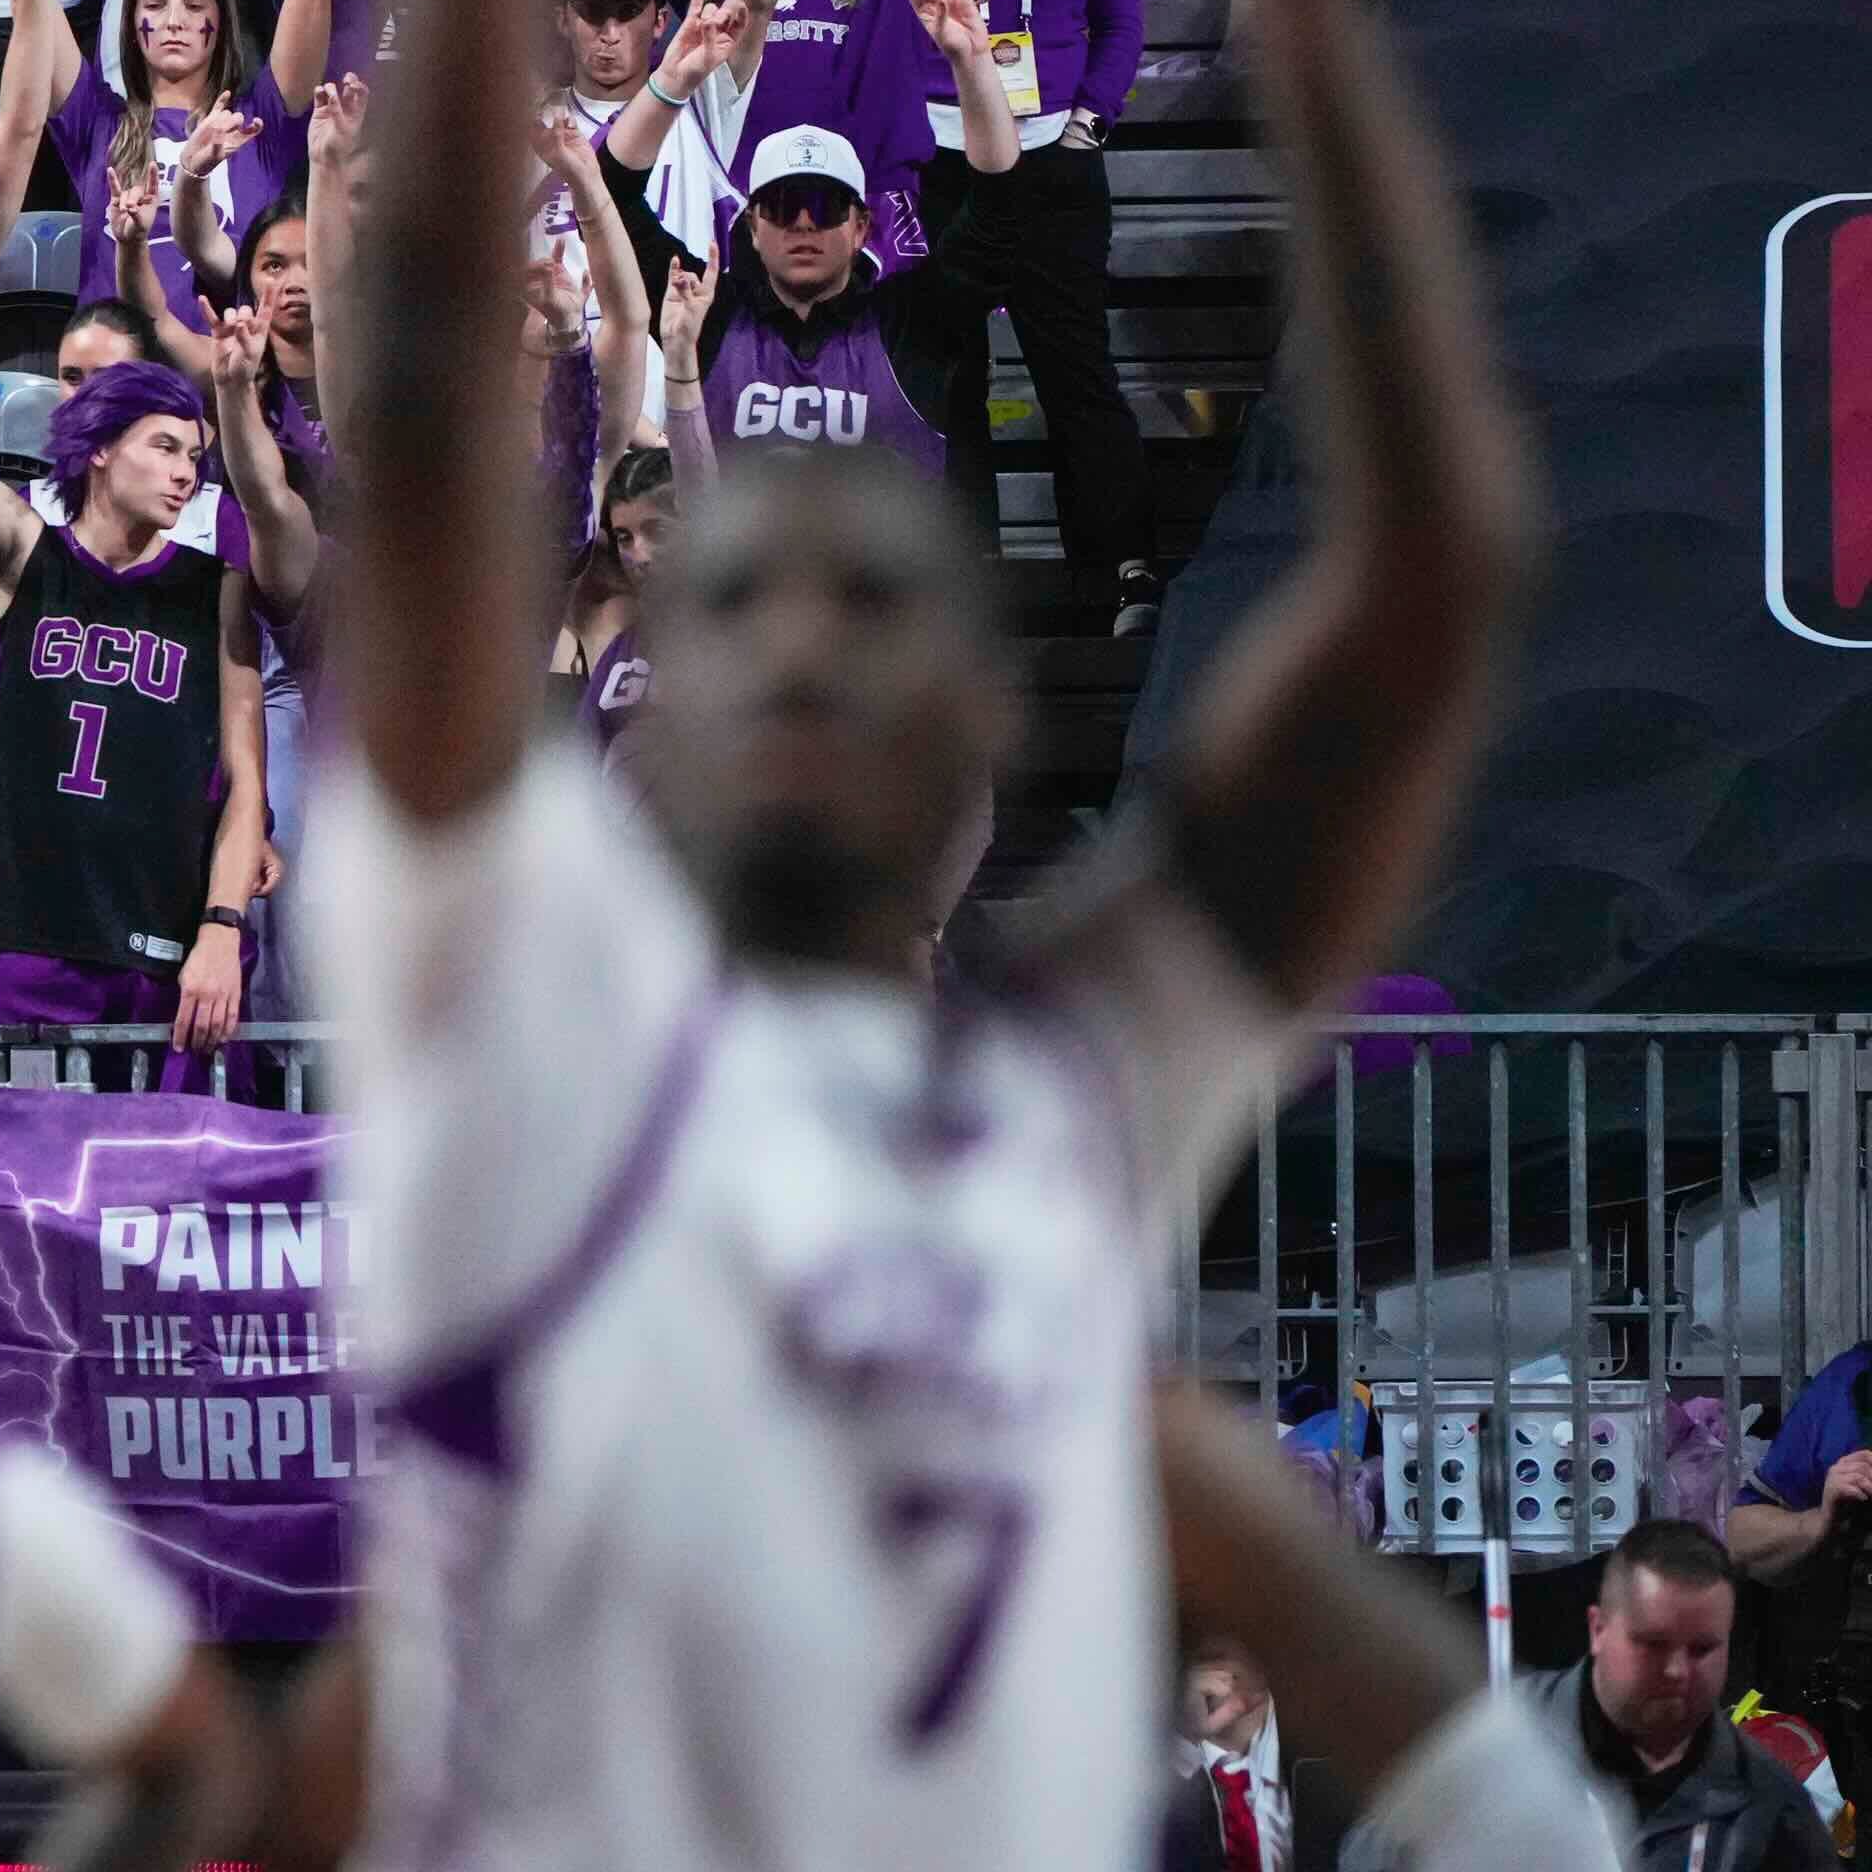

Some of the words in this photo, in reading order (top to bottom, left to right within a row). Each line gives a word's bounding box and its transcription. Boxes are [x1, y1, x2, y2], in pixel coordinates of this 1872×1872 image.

[733, 383, 863, 445] GCU
[30, 616, 186, 703] GCU
[57, 701, 107, 799] 1
[105, 1312, 195, 1376] THE
[872, 1483, 1036, 1746] 7
